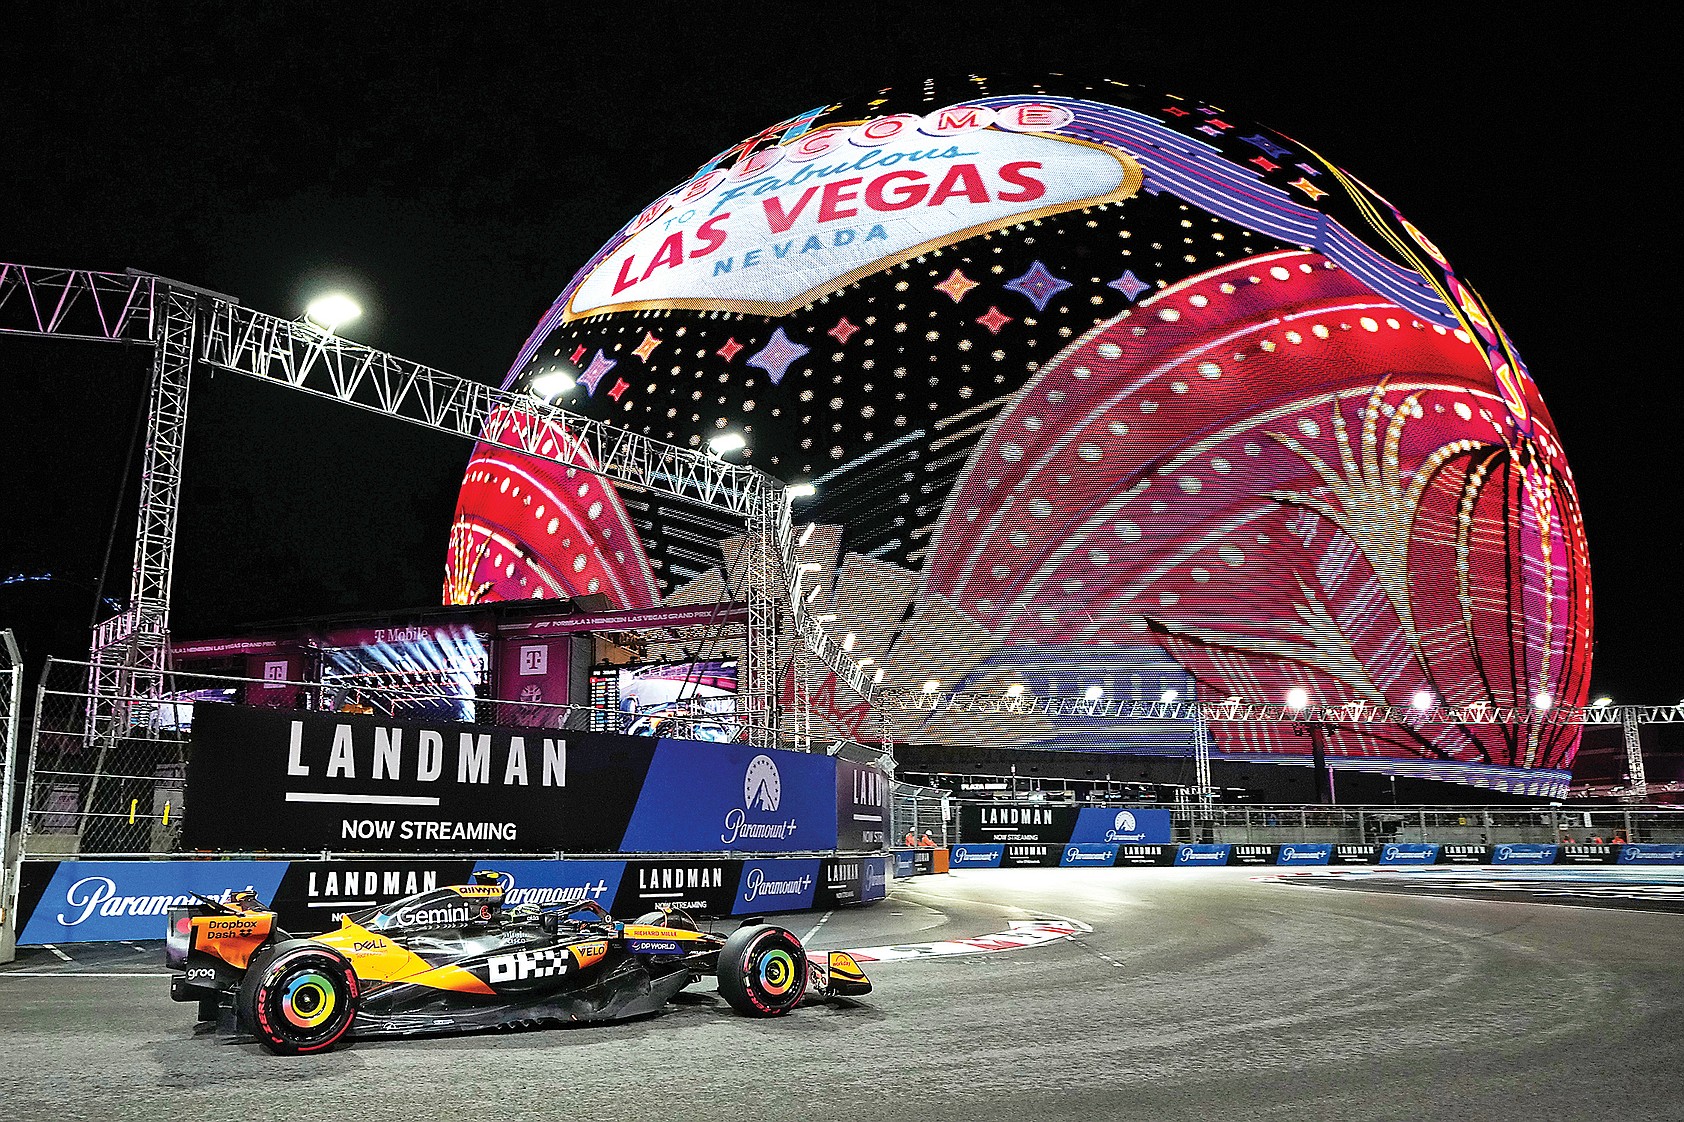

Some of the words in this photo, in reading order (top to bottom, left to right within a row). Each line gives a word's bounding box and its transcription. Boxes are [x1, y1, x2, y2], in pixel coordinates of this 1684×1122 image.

[635, 104, 1054, 230] WELCOME
[663, 209, 696, 231] TO
[709, 145, 980, 216] Fabulous
[611, 212, 731, 296] LAS
[762, 160, 1046, 234] VEGAS
[713, 224, 888, 276] NEVADA
[643, 613, 668, 621] VEGAS
[695, 610, 712, 618] PRIX
[387, 627, 428, 641] Mobile
[287, 721, 567, 787] LANDMAN
[721, 808, 797, 844] Paramount+
[980, 808, 1053, 825] LANDMAN
[341, 819, 395, 840] NOW
[399, 821, 517, 840] STREAMING
[1009, 846, 1047, 856] LANDMAN
[308, 870, 437, 897] LANDMAN
[639, 867, 722, 889] LANDMAN
[744, 868, 812, 902] Paramount+
[396, 902, 470, 927] Gemini
[672, 901, 708, 909] STREAMING
[208, 919, 258, 930] Dropbox
[207, 930, 236, 939] Dash
[353, 938, 387, 952] DELL
[578, 946, 605, 957] VELO
[641, 942, 651, 950] DP
[651, 942, 677, 950] WORLD
[187, 968, 216, 980] groq
